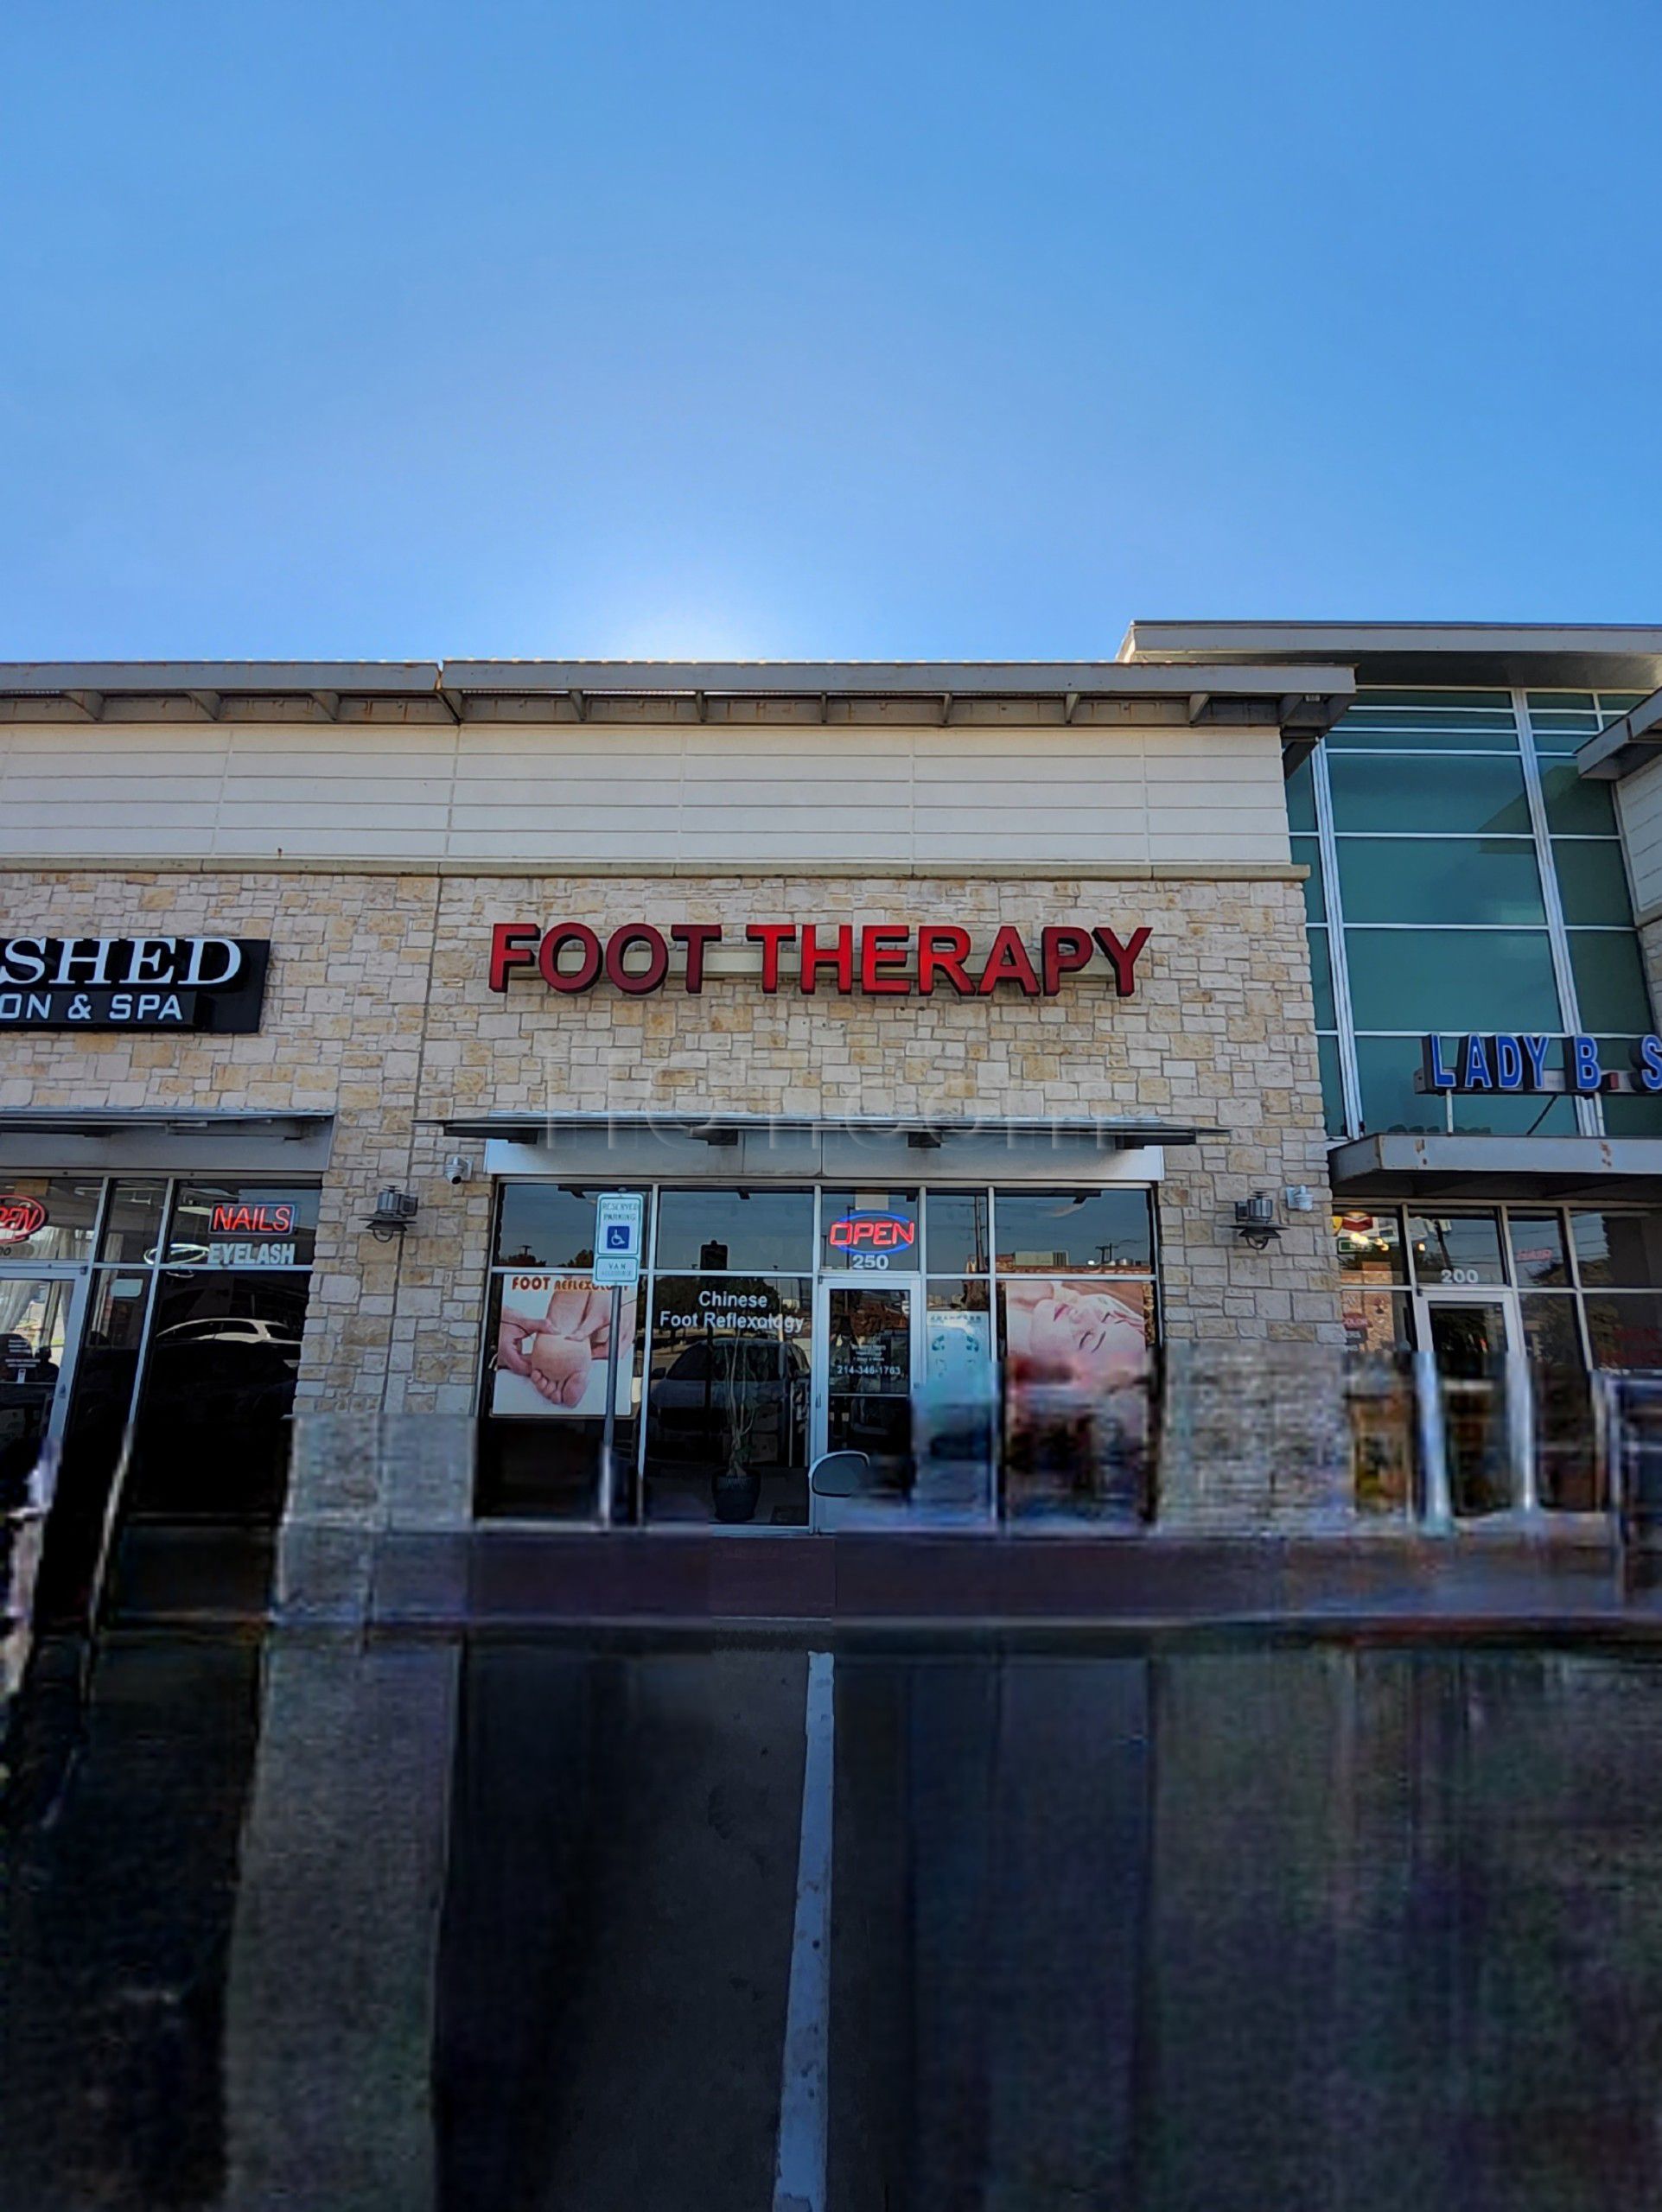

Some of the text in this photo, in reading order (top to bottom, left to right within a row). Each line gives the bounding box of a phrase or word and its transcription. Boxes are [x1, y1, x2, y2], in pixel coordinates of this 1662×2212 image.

[488, 923, 1154, 997] FOOT THERAPY
[67, 994, 92, 1020] &
[109, 994, 182, 1020] SPA
[1428, 1033, 1550, 1089] LADY
[213, 1206, 290, 1232] NAILS
[830, 1221, 915, 1245] OPEN
[208, 1243, 295, 1265] EYELASH
[852, 1254, 889, 1270] 250
[512, 1276, 551, 1290] FOOT
[1441, 1268, 1479, 1284] 200
[698, 1291, 768, 1308] Chinese
[659, 1311, 804, 1333] Foot Reflexology
